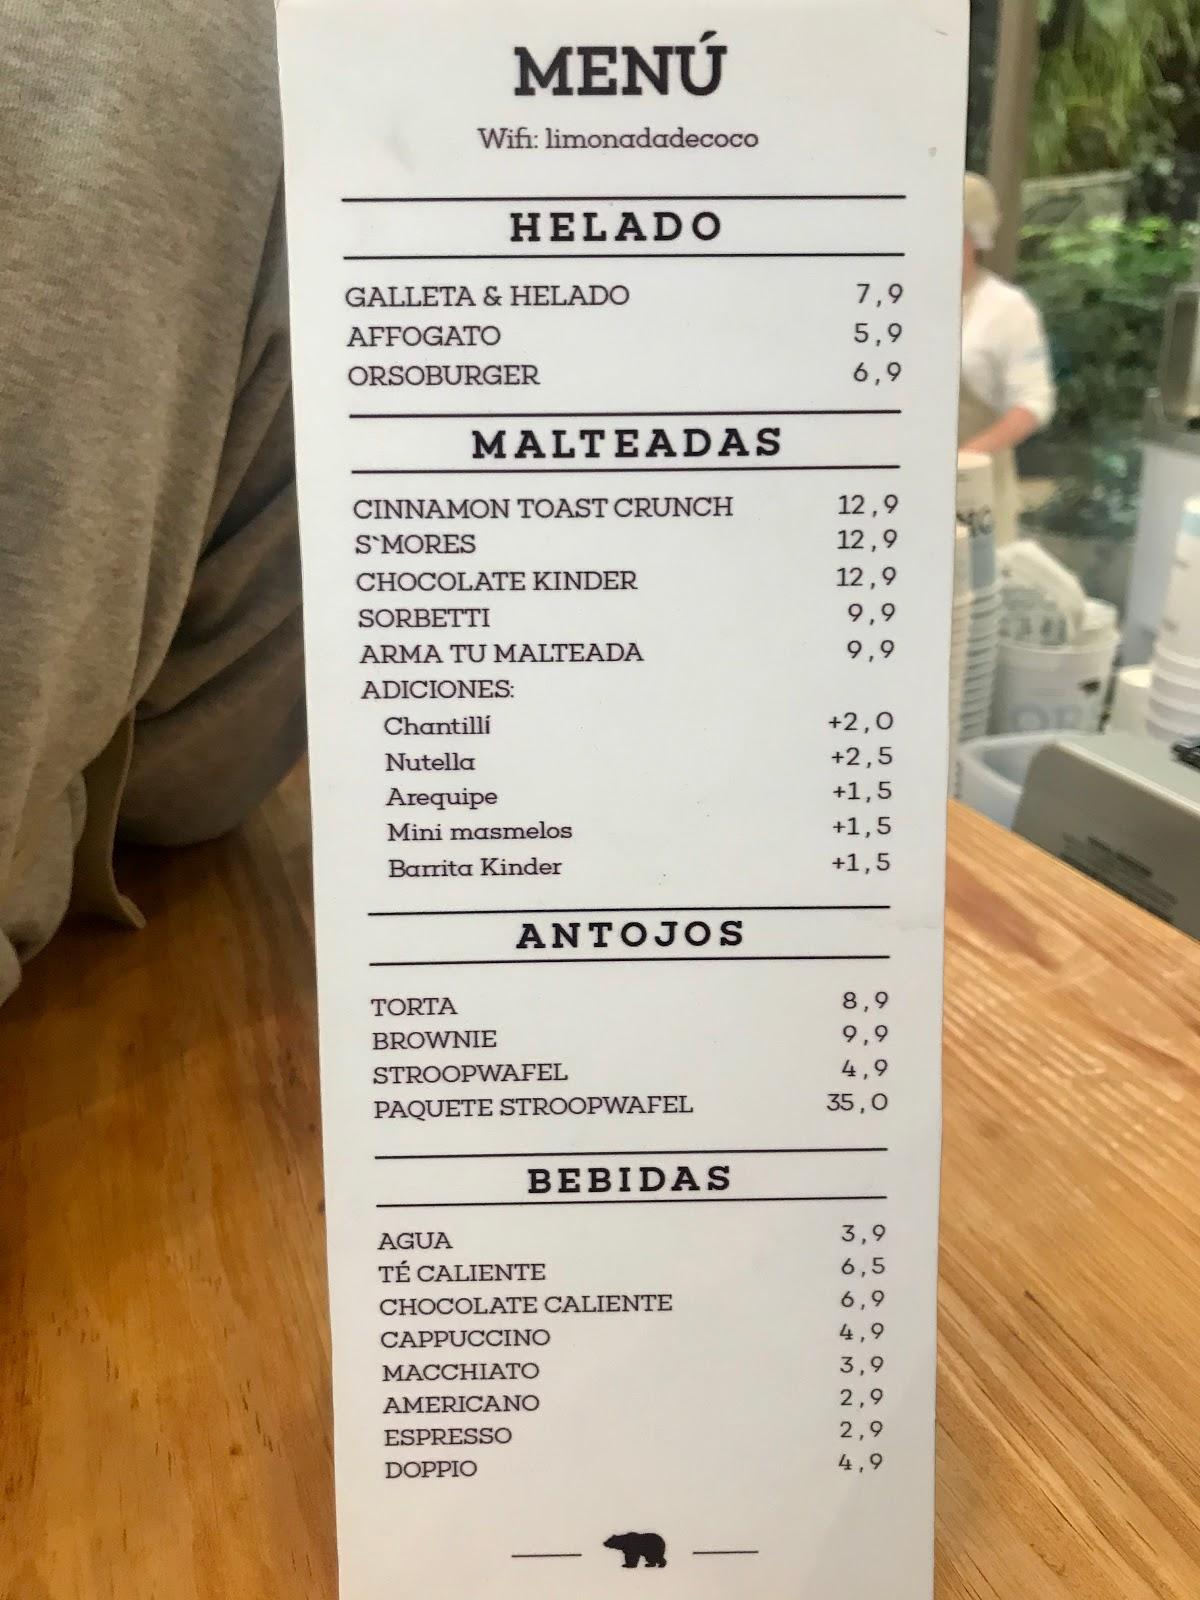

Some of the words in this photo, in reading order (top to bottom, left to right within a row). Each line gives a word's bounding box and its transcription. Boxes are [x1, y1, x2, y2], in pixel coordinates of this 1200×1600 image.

[513, 29, 729, 97] MENÚ
[476, 126, 539, 150] Wifi:
[544, 126, 760, 150] limonadadecoco
[509, 210, 722, 243] HELADO
[344, 285, 477, 308] GALLETA
[482, 285, 504, 307] &
[509, 284, 631, 307] HELADO
[856, 282, 904, 308] 7,9
[345, 325, 502, 348] AFFOGATO
[853, 322, 903, 347] 5,9
[347, 363, 542, 387] ORSOBURGER
[852, 361, 902, 387] 6,9
[470, 426, 781, 460] MALTEADAS
[352, 498, 511, 520] CINNAMON
[516, 497, 610, 520] TOAST
[612, 495, 734, 518] CRUNCH
[837, 493, 899, 518] 12,9
[836, 528, 898, 553] 12,9
[355, 570, 527, 592] CHOCOLATE
[531, 569, 639, 592] KINDER
[836, 566, 897, 590] 12,9
[357, 607, 491, 629] SORBETTI
[847, 602, 896, 626] 9,9
[358, 643, 445, 665] ARMA
[449, 643, 488, 664] TU
[492, 642, 645, 664] MALTEADA
[846, 639, 896, 663] 9,9
[360, 679, 515, 700] ADICIONES:
[383, 714, 492, 736] Chantillí
[827, 711, 894, 734] +2,0
[384, 751, 476, 772] Nutella
[831, 746, 893, 769] +2,5
[384, 787, 499, 811] Arequipe
[832, 780, 893, 804] +1,5
[386, 822, 444, 842] Mini
[449, 820, 573, 841] masmelos
[832, 815, 892, 839] +1,5
[387, 858, 474, 879] Barrita
[479, 856, 563, 877] Kinder
[831, 852, 891, 875] +1,5
[515, 920, 743, 950] ANTOJOS
[370, 996, 459, 1017] TORTA
[842, 990, 890, 1013] 8,9
[371, 1029, 498, 1051] BROWNIE
[842, 1024, 889, 1047] 9,9
[372, 1062, 569, 1085] STROOPWAFEL
[841, 1058, 889, 1081] 4,9
[373, 1098, 494, 1122] PAQUETE
[499, 1094, 694, 1117] STROOPWAFEL
[826, 1092, 889, 1115] 35,0
[526, 1165, 730, 1195] BEBIDAS
[376, 1231, 454, 1251] AGUA
[841, 1223, 887, 1246] 3,9
[377, 1259, 411, 1284] TÉ
[416, 1262, 547, 1283] CALIENTE
[840, 1256, 886, 1278] 6,5
[378, 1296, 538, 1317] CHOCOLATE
[543, 1293, 673, 1314] CALIENTE
[839, 1289, 886, 1311] 6,9
[380, 1328, 552, 1349] CAPPUCCINO
[839, 1322, 885, 1343] 4,9
[381, 1361, 541, 1382] MACCHIATO
[839, 1355, 884, 1377] 3,9
[381, 1394, 540, 1415] AMERICANO
[839, 1387, 884, 1409] 2,9
[383, 1426, 513, 1447] ESPRESSO
[839, 1420, 884, 1441] 2,9
[384, 1459, 478, 1480] DOPPIO
[838, 1452, 883, 1473] 4,9
